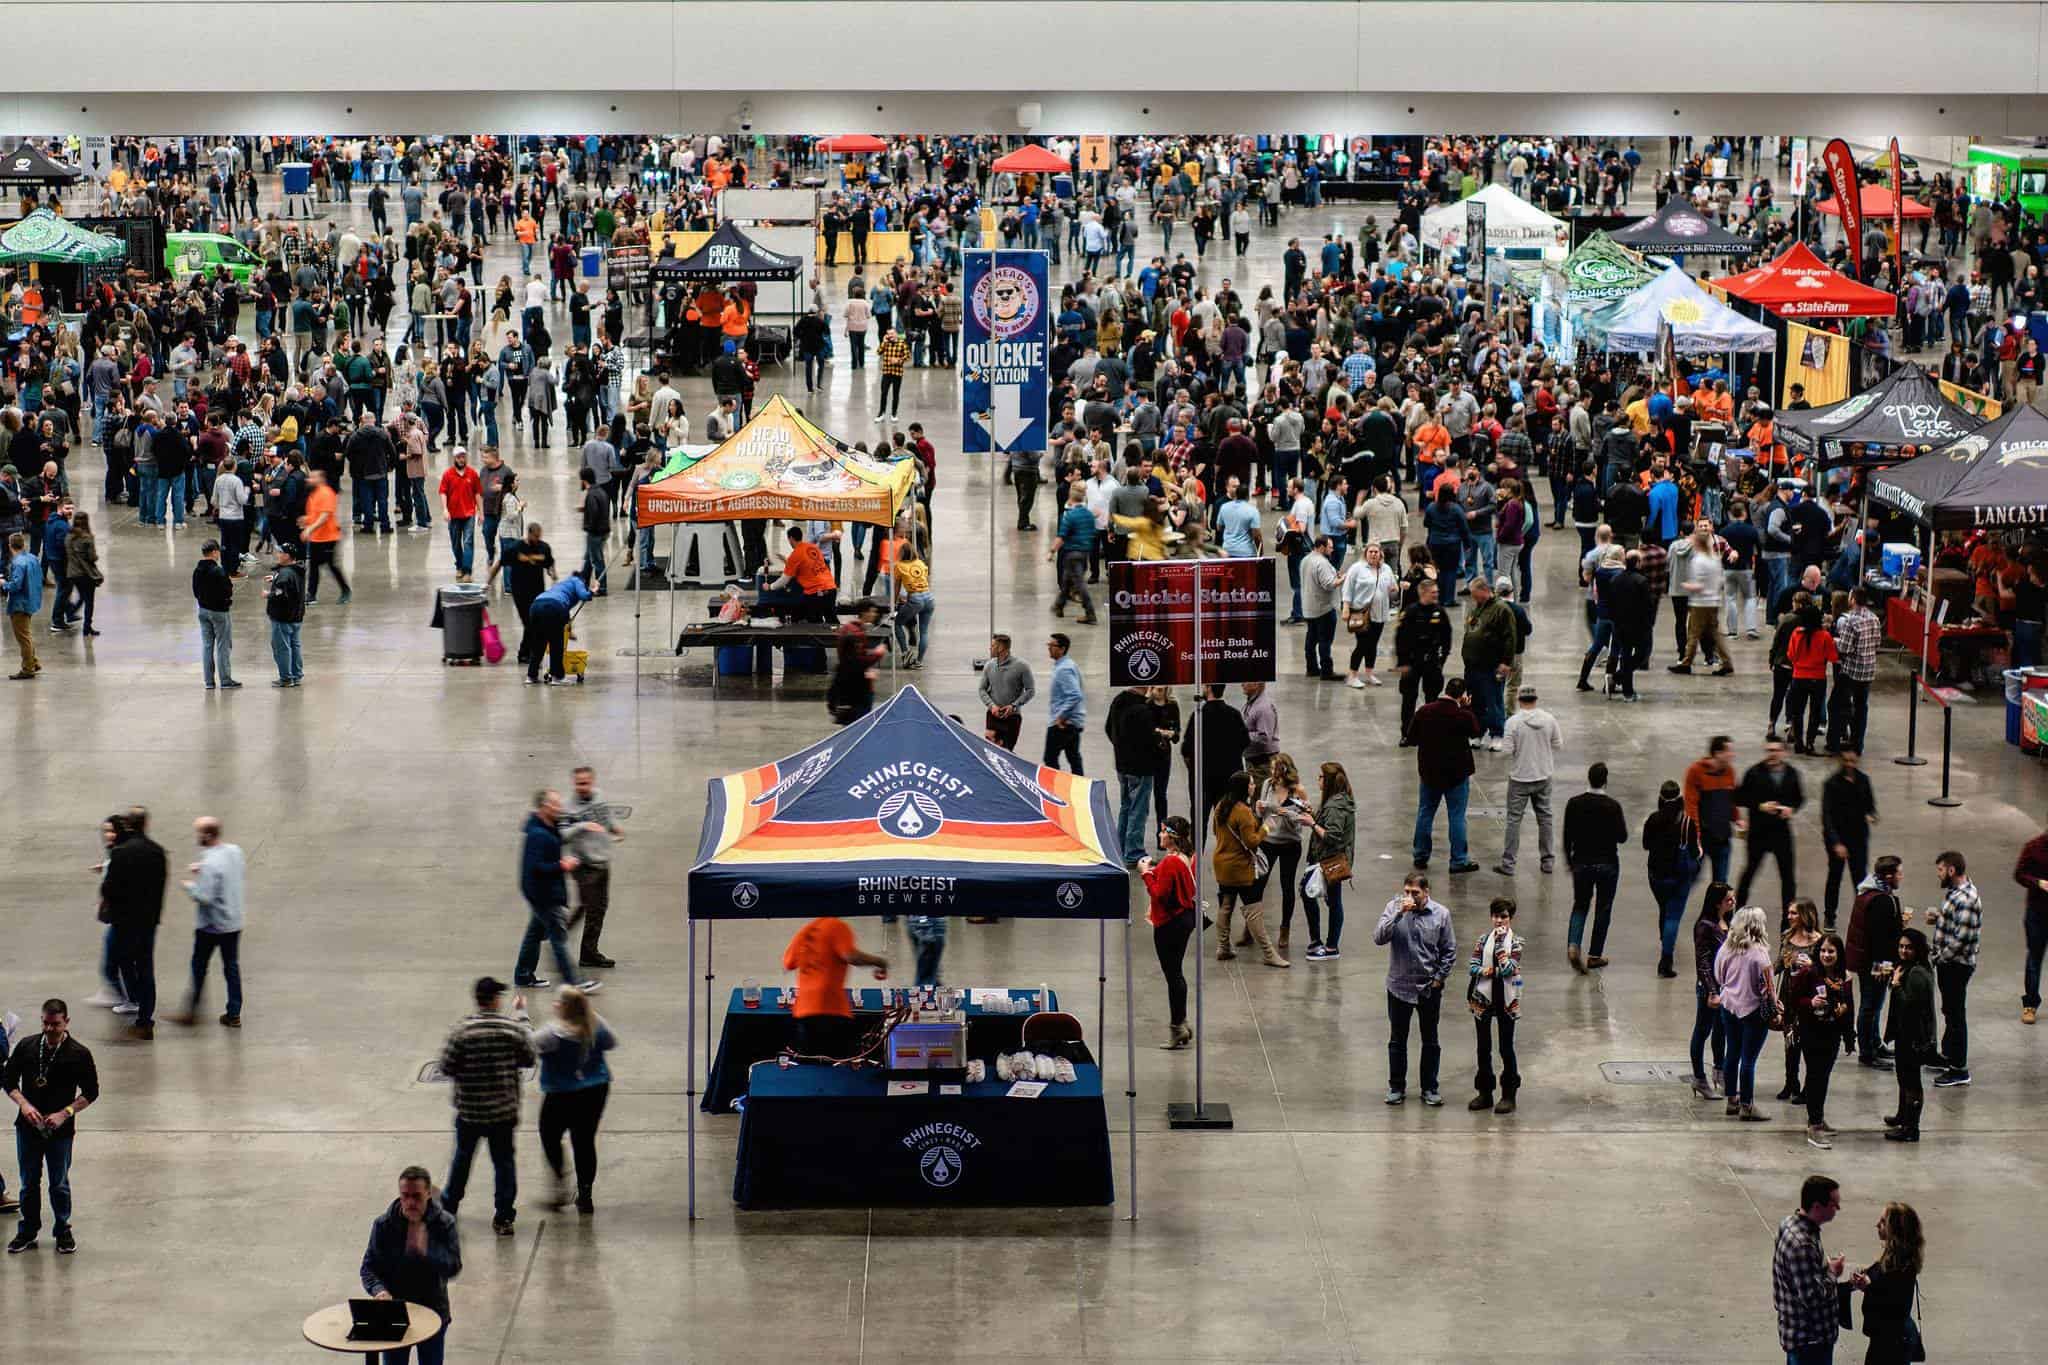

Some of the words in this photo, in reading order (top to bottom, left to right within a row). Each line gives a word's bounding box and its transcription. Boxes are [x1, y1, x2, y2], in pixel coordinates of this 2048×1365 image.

[708, 245, 741, 258] GREAT
[707, 256, 741, 268] LAKES
[1782, 268, 1806, 276] State
[1808, 268, 1831, 276] Farm
[966, 342, 1043, 368] QUICKIE
[982, 367, 1029, 384] STATION
[1883, 402, 1942, 422] enjoy
[751, 426, 792, 444] HEAD
[736, 441, 795, 458] HUNTER
[648, 498, 713, 513] UNCIVILIZED
[716, 501, 725, 512] &
[728, 496, 792, 511] AGGRESSIVE
[801, 498, 881, 513] FATHEADS.COM
[1974, 504, 2048, 525] LANCAST
[1114, 590, 1193, 609] Quickie
[1200, 588, 1272, 603] Station
[1113, 631, 1175, 653] RHINEGEIST
[1227, 637, 1254, 647] Bubs
[1224, 649, 1249, 659] Rosé
[1251, 649, 1269, 659] Ale
[848, 761, 973, 800] RHINEGEIST
[873, 780, 905, 800] CINCY
[918, 780, 947, 800] MADE
[858, 876, 957, 891] RHINEGEIST
[858, 893, 956, 904] BREWERY
[902, 1122, 982, 1149] RHINEGEIST
